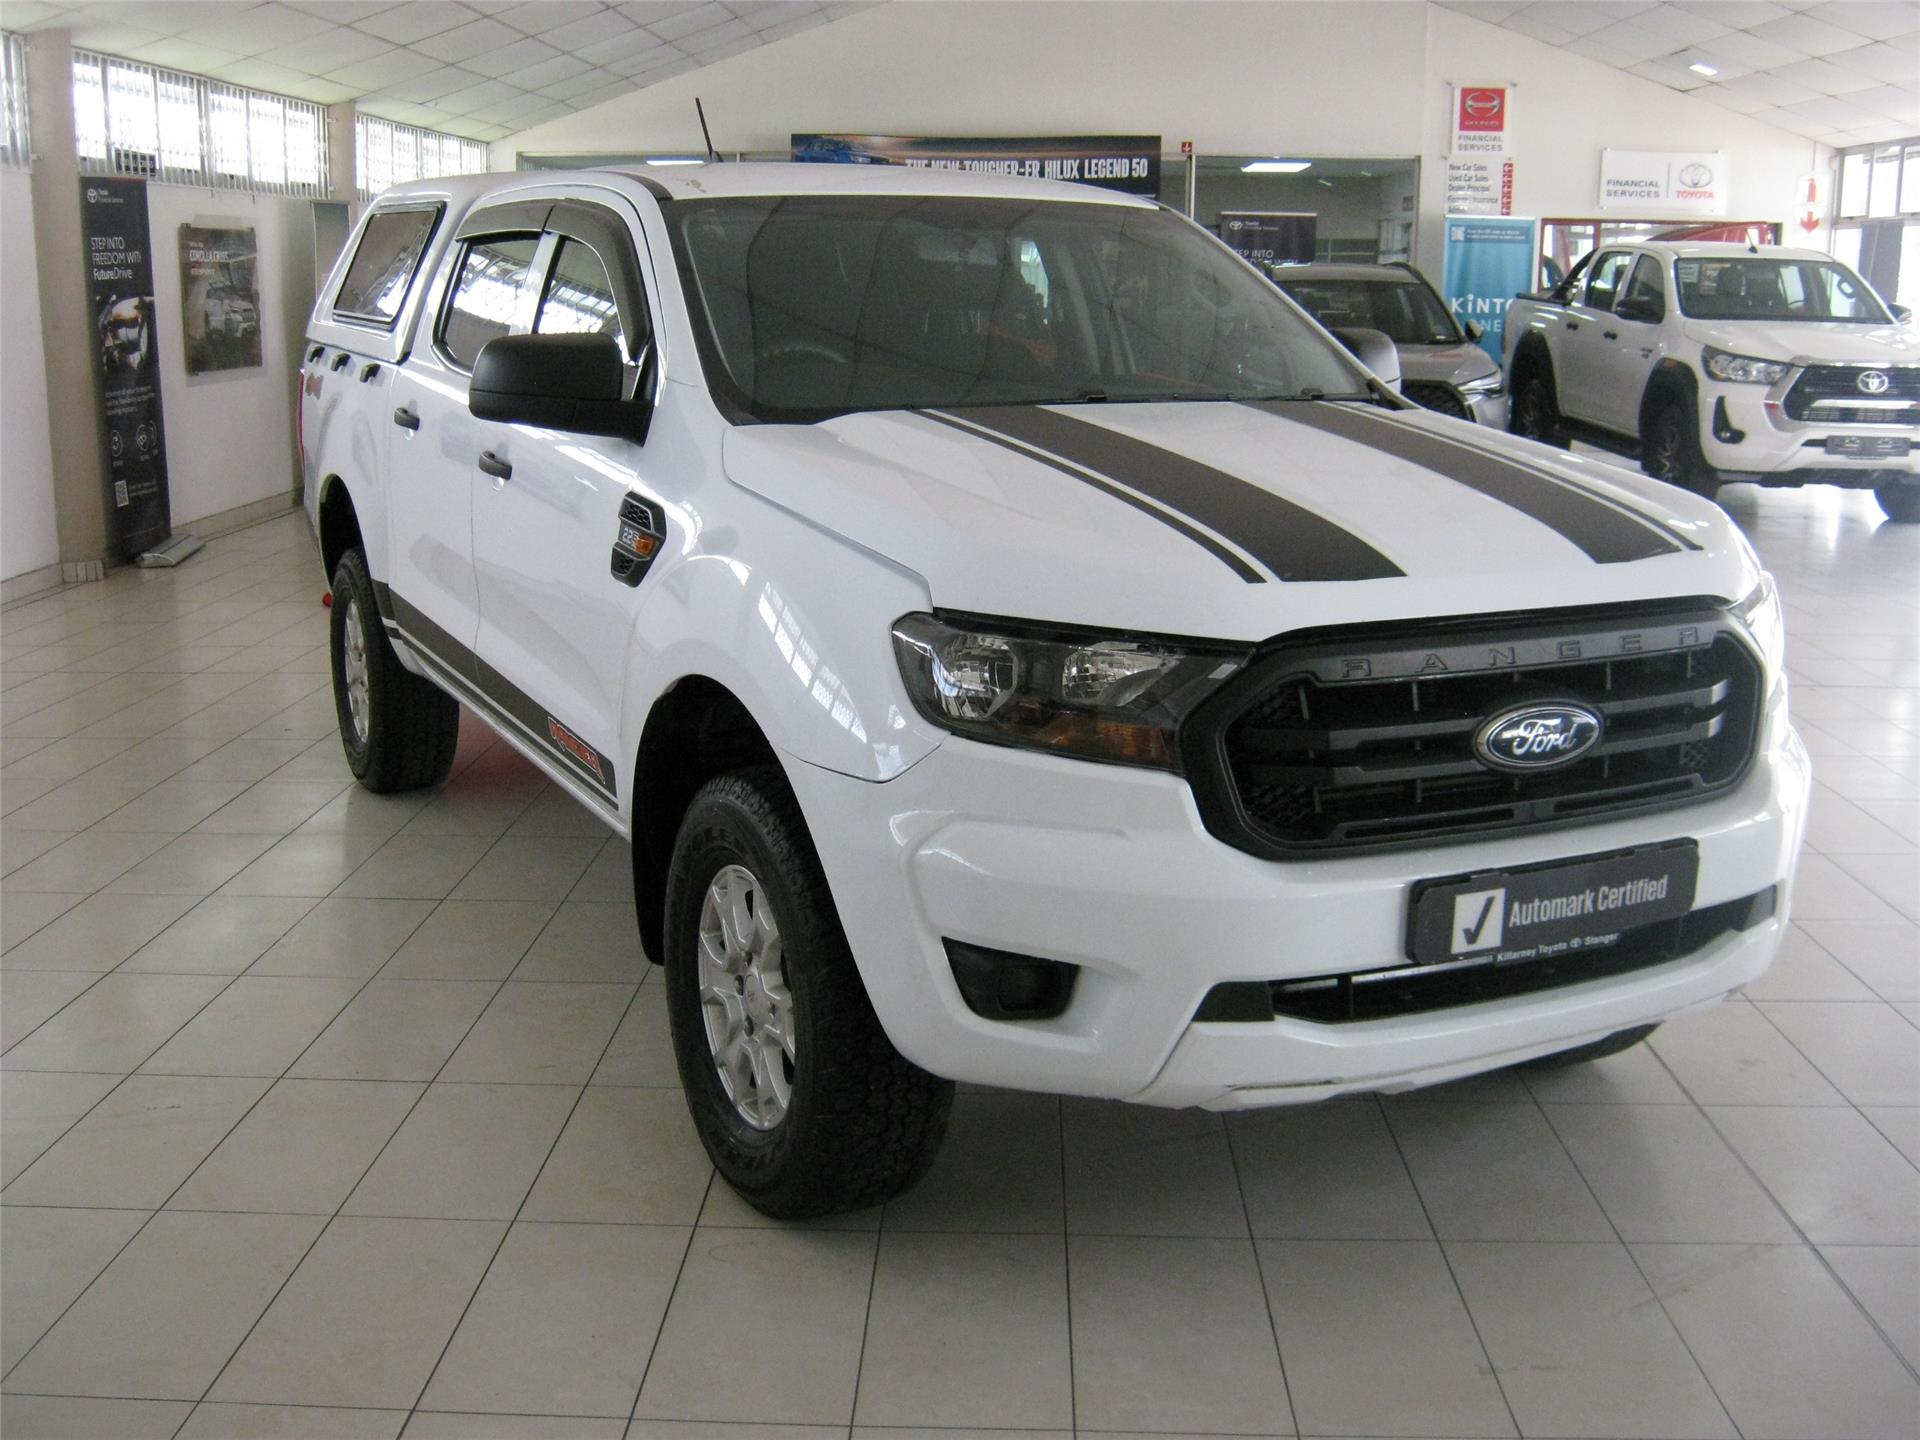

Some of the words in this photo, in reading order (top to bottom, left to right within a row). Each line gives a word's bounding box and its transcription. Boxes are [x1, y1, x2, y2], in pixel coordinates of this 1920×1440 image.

[1458, 143, 1504, 152] SERVICES
[1044, 159, 1080, 180] HILUX
[1083, 158, 1130, 180] LEGEND
[1131, 158, 1149, 178] 50
[1606, 179, 1661, 189] FINANCIAL
[1606, 189, 1661, 199] SERVICES
[1675, 190, 1715, 200] TOYOTA
[1342, 626, 1699, 679] RANGER
[1510, 717, 1578, 756] Ford
[1509, 889, 1595, 928] Automark
[1598, 874, 1669, 911] Certified
[1497, 948, 1537, 963] Killarney
[1538, 942, 1568, 955] Toyota
[1584, 931, 1620, 947] Stanger
